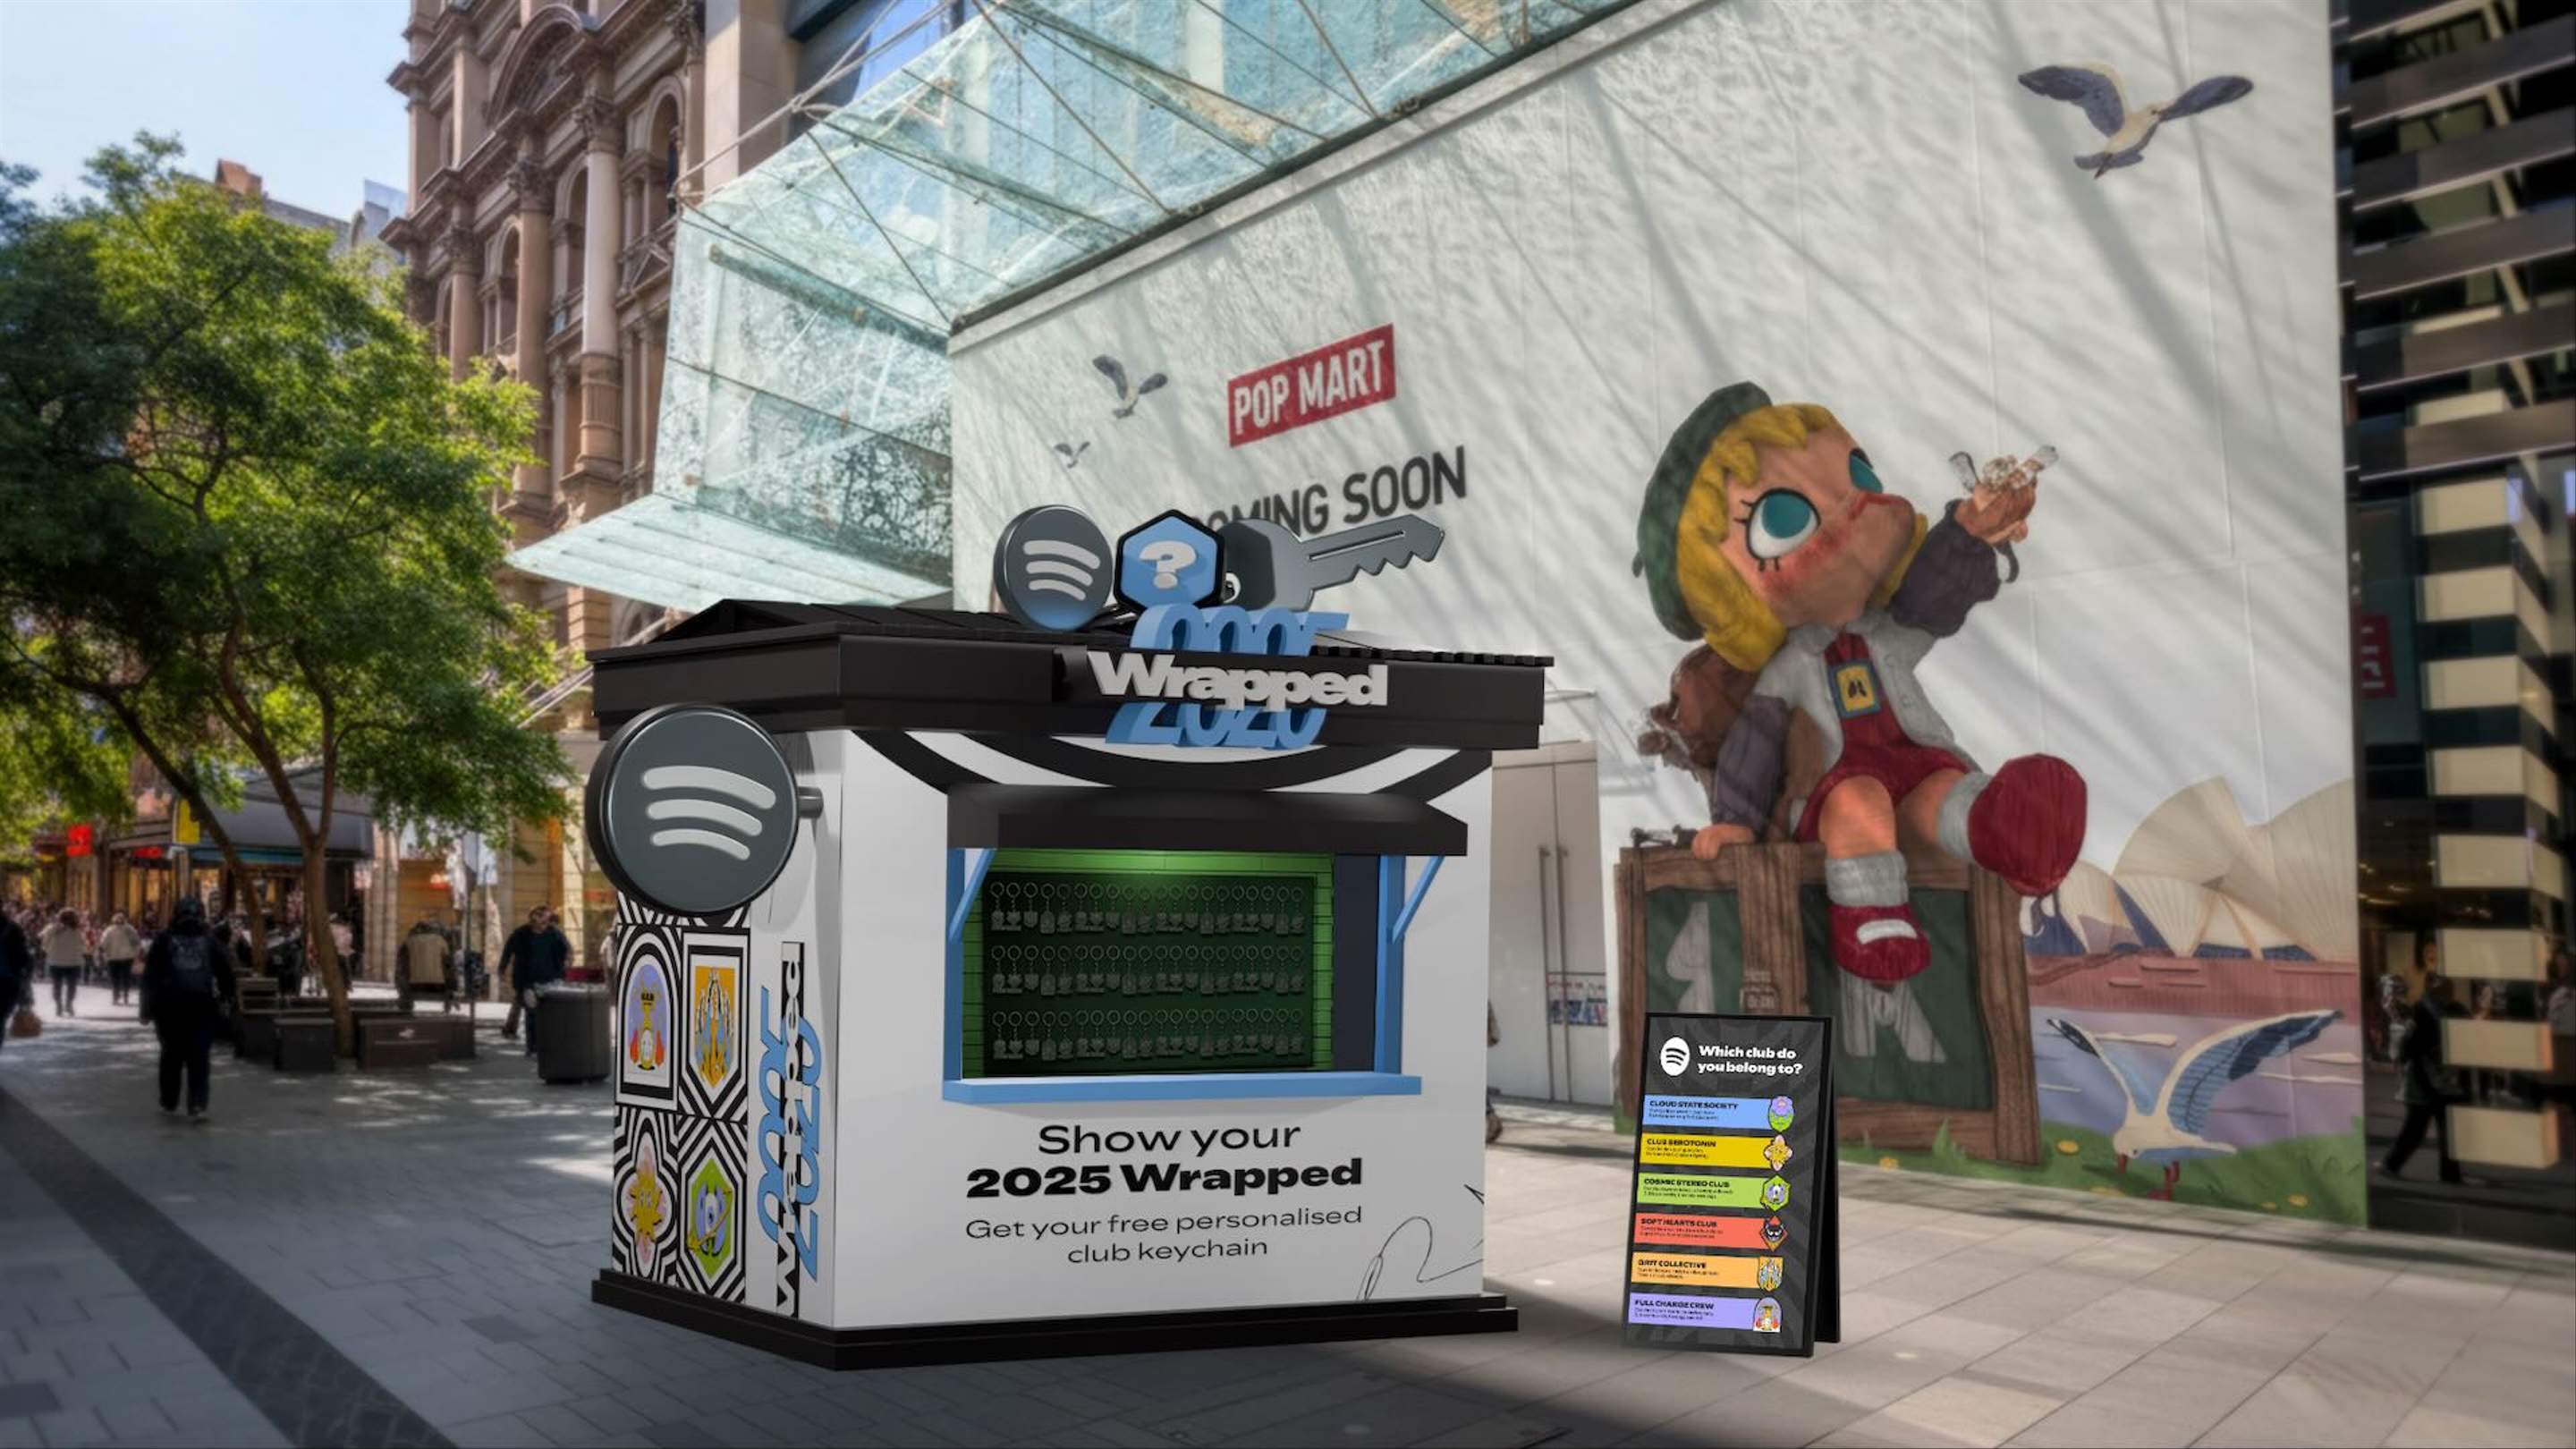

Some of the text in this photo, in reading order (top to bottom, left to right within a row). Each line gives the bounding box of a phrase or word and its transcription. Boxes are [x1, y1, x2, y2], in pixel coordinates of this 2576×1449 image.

[1234, 340, 1385, 436] POP MART
[1343, 444, 1467, 524] SOON
[1086, 650, 1389, 712] Wrapped
[1699, 1045, 1797, 1059] Which club do
[1697, 1061, 1803, 1077] you belong to?
[1649, 1100, 1677, 1108] CLOUD
[1677, 1101, 1704, 1109] STATE
[1038, 1124, 1301, 1157] Show your
[966, 1157, 1362, 1198] 2025 Wrapped
[965, 1206, 1362, 1241] Get your free personalised
[1696, 1219, 1717, 1228] CLUB
[1067, 1238, 1268, 1264] club keychain
